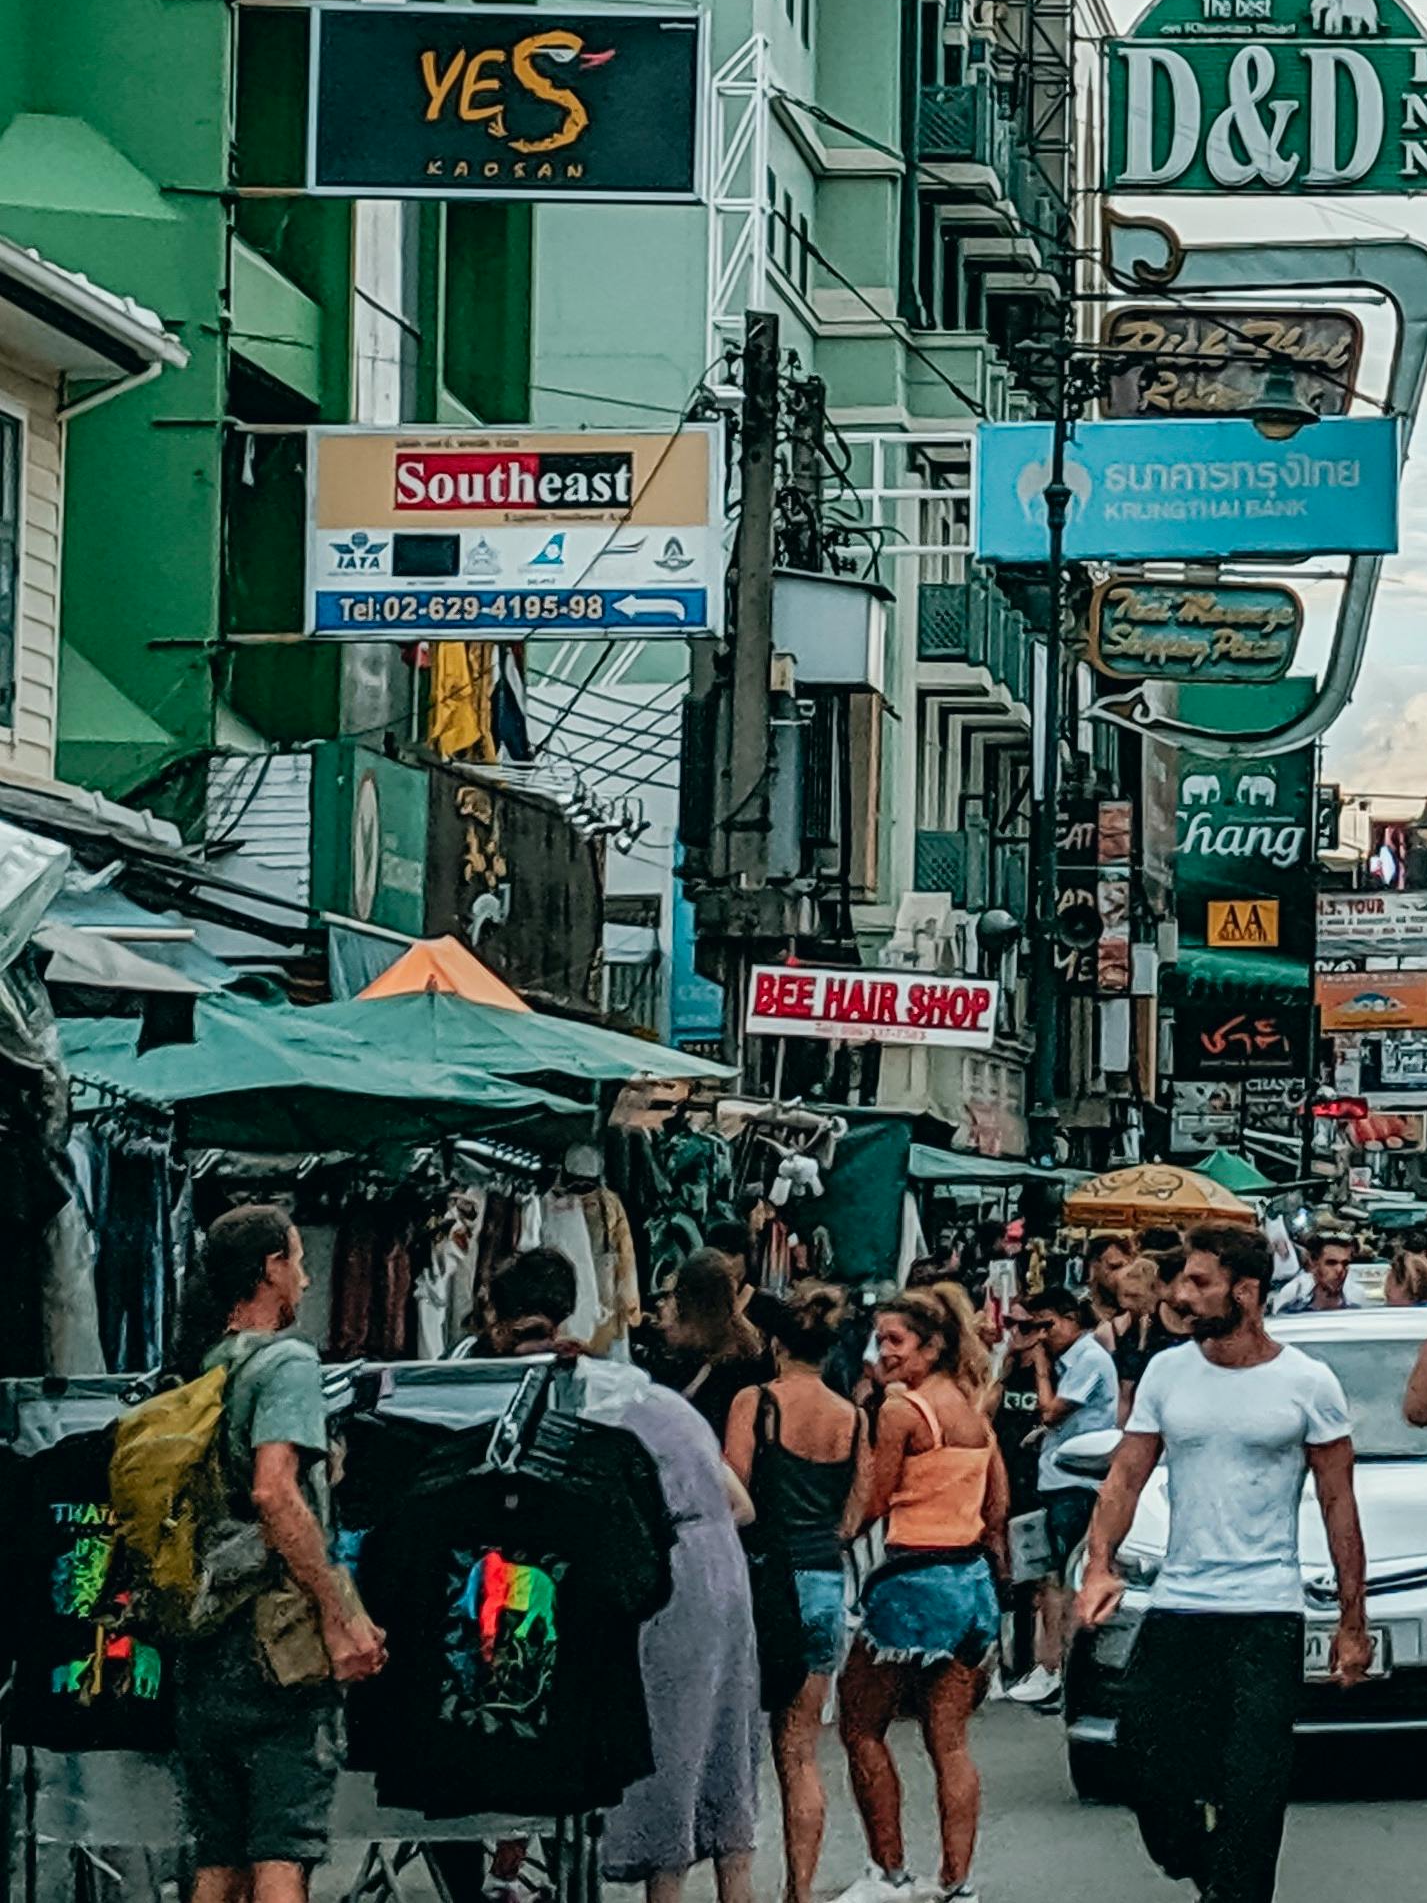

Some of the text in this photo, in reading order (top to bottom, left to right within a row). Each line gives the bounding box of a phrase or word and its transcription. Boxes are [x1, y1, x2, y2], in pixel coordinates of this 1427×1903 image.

[421, 30, 590, 154] YES
[1115, 45, 1385, 187] D&D
[427, 160, 584, 179] KAOSAN
[397, 461, 633, 505] Southeast
[1104, 452, 1361, 499] ธนาคารกรุงไทย
[1104, 498, 1309, 521] KRUNGTHAI BANK
[336, 555, 381, 571] IATA
[339, 595, 603, 622] Tel:02-629-4195-98
[757, 972, 992, 1030] BEE HAIR SHOP
